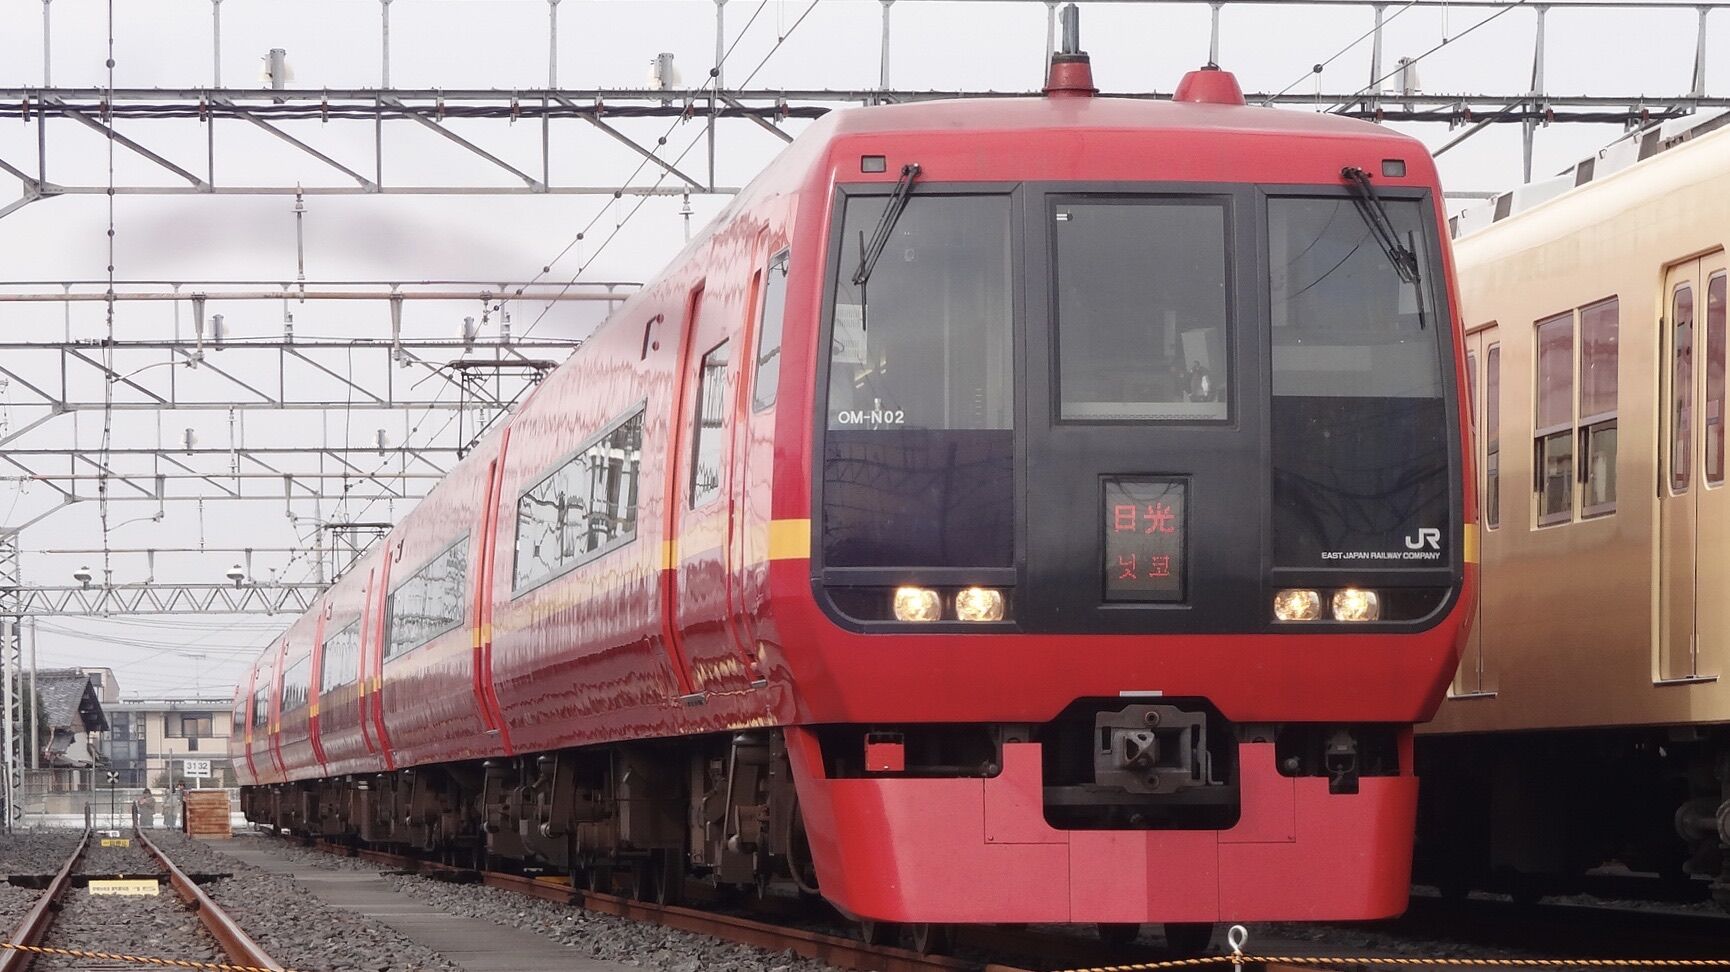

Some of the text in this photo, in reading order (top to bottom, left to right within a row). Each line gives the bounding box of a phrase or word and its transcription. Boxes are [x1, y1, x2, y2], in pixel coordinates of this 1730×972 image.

[838, 410, 905, 424] OM-N02
[1114, 502, 1175, 534] 日光
[1405, 527, 1440, 549] JR
[1321, 551, 1440, 559] EAST JAPAN RAILWAY COMPANY
